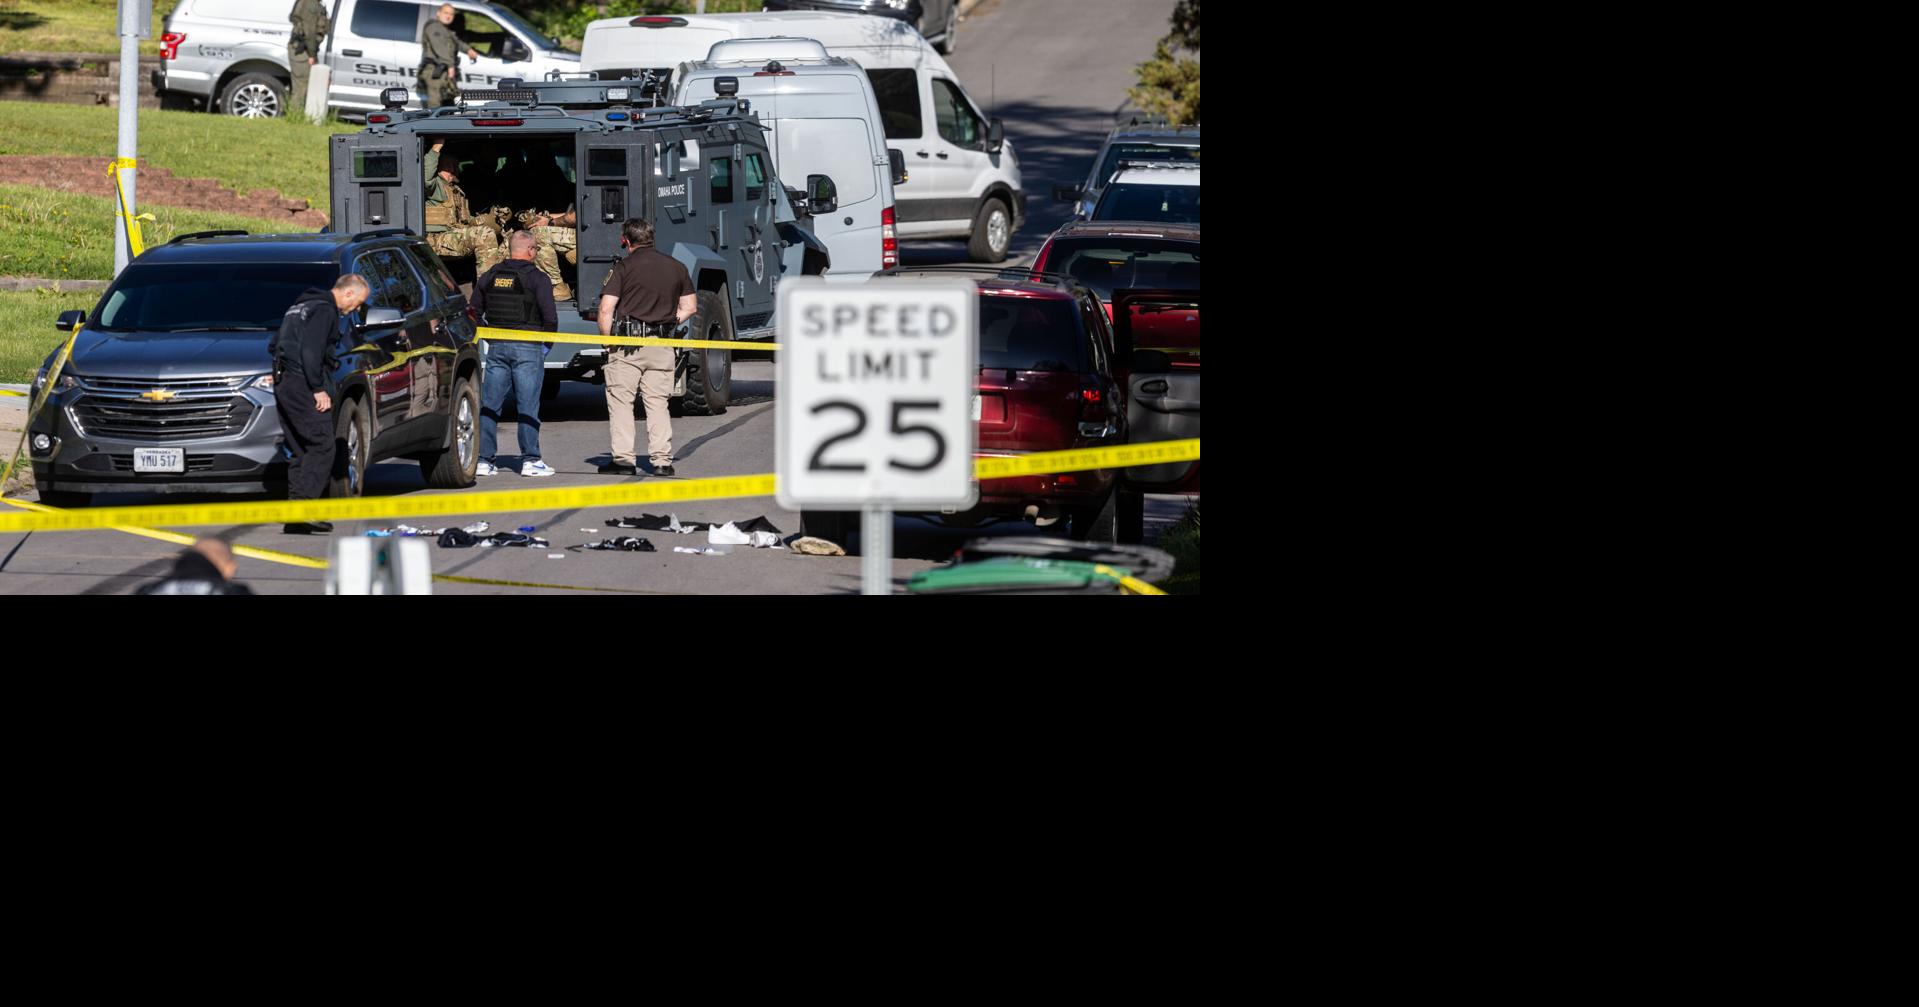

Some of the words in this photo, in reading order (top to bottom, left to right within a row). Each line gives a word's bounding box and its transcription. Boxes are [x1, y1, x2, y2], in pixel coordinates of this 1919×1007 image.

[658, 186, 671, 197] OMAHA
[671, 184, 684, 195] POLICE
[494, 278, 513, 287] SHERIFF
[803, 304, 957, 337] SPEED
[818, 351, 936, 382] LIMIT
[808, 401, 946, 472] 25
[141, 455, 158, 467] YMU
[160, 455, 177, 467] 517
